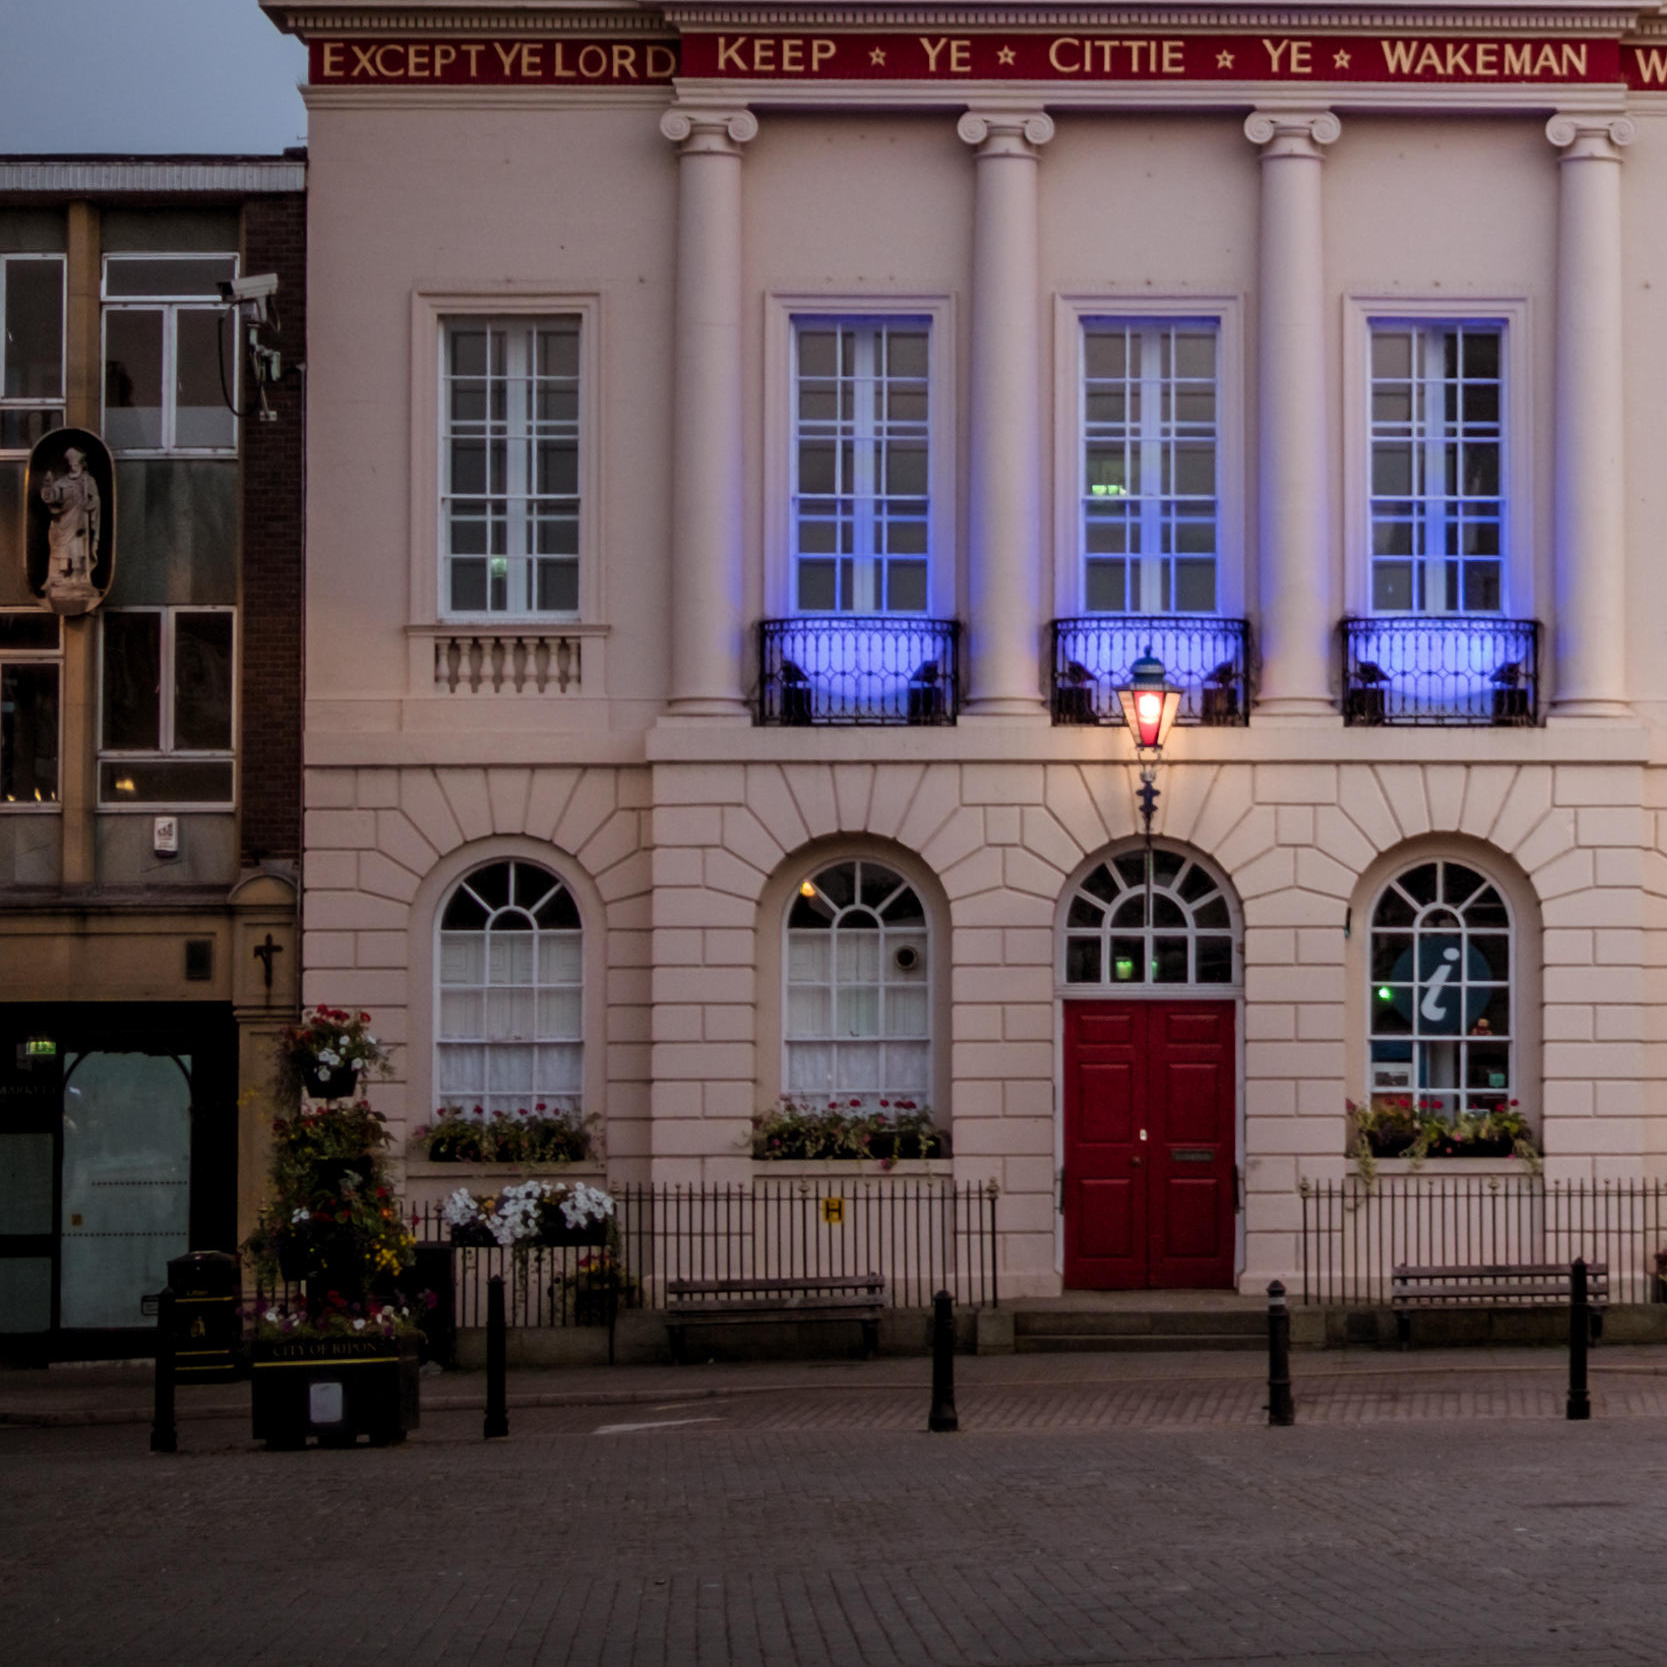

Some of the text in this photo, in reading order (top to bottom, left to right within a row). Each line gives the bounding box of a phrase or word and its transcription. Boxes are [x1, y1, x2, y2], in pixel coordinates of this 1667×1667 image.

[322, 42, 677, 79] EXCEPT YE LORD
[717, 37, 1588, 76] KEEP YE CITTIE YE WAKEMAN
[825, 1200, 842, 1221] H
